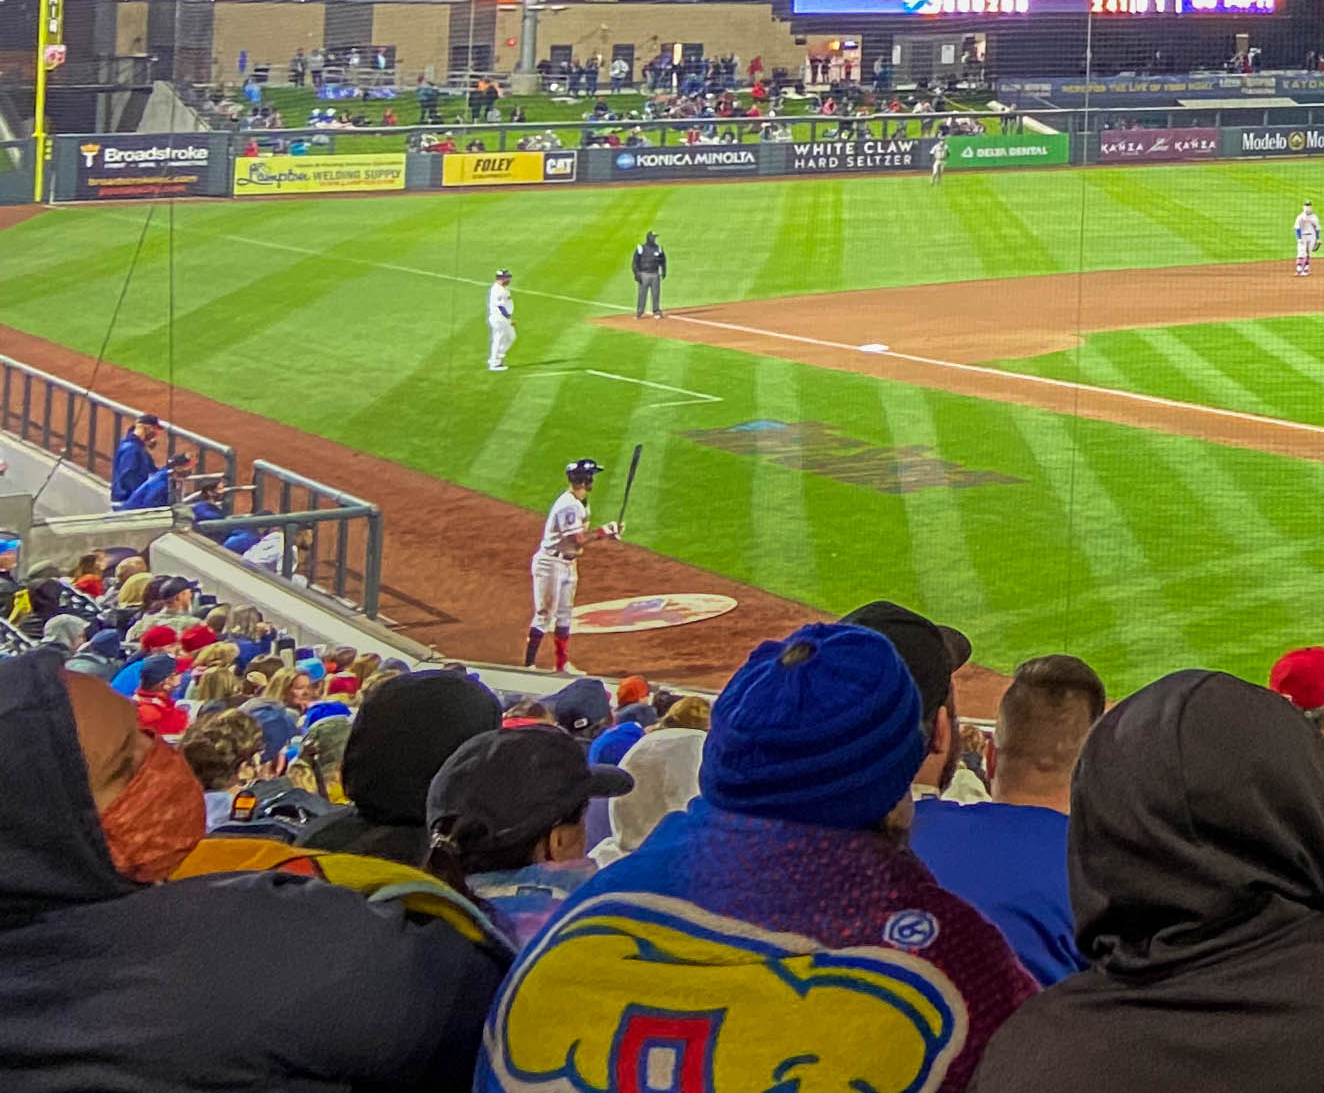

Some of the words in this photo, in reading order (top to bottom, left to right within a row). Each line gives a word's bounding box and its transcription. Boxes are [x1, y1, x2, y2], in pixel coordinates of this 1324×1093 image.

[794, 140, 855, 156] WHITE
[864, 139, 914, 155] CLAW
[1101, 141, 1145, 153] KANZA
[1174, 139, 1217, 152] KANZA
[1242, 132, 1287, 150] Modelo
[104, 145, 209, 162] Broadstroke
[636, 153, 692, 167] KONICA
[694, 151, 755, 165] MINOLTA
[473, 158, 515, 173] FOLEY
[546, 157, 574, 175] CAT
[794, 156, 845, 170] HARD
[847, 154, 913, 168] SELTZER
[313, 170, 360, 181] WELDING
[365, 169, 402, 180] SUPPLY
